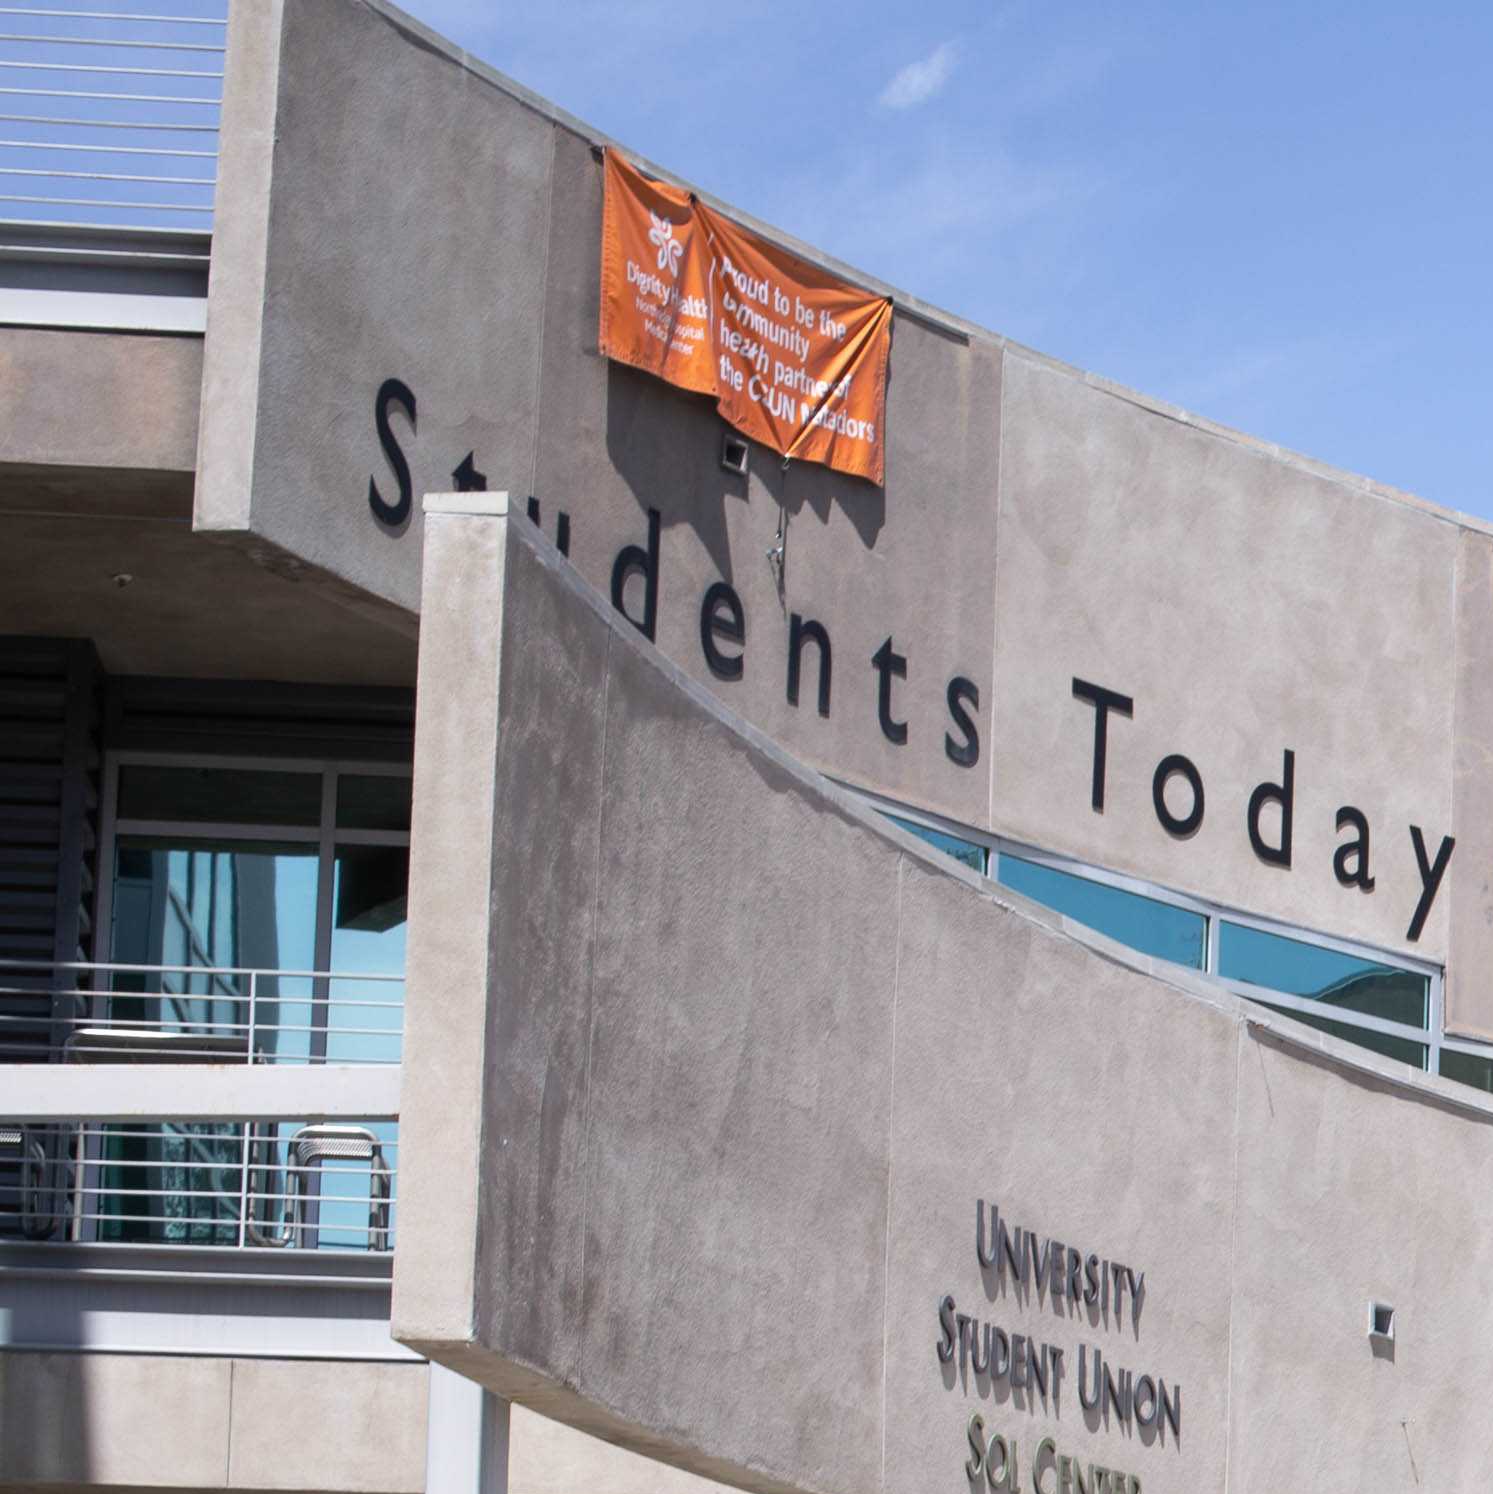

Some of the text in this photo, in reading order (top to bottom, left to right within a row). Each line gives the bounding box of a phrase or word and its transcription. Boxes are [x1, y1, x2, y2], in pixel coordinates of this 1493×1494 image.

[626, 258, 671, 307] Dignity
[720, 255, 847, 342] Proud to be the
[719, 354, 743, 392] the
[975, 1198, 1146, 1325] UNIVERSITY
[936, 1294, 1181, 1438] STUDENT UNION
[964, 1411, 1021, 1494] SOL
